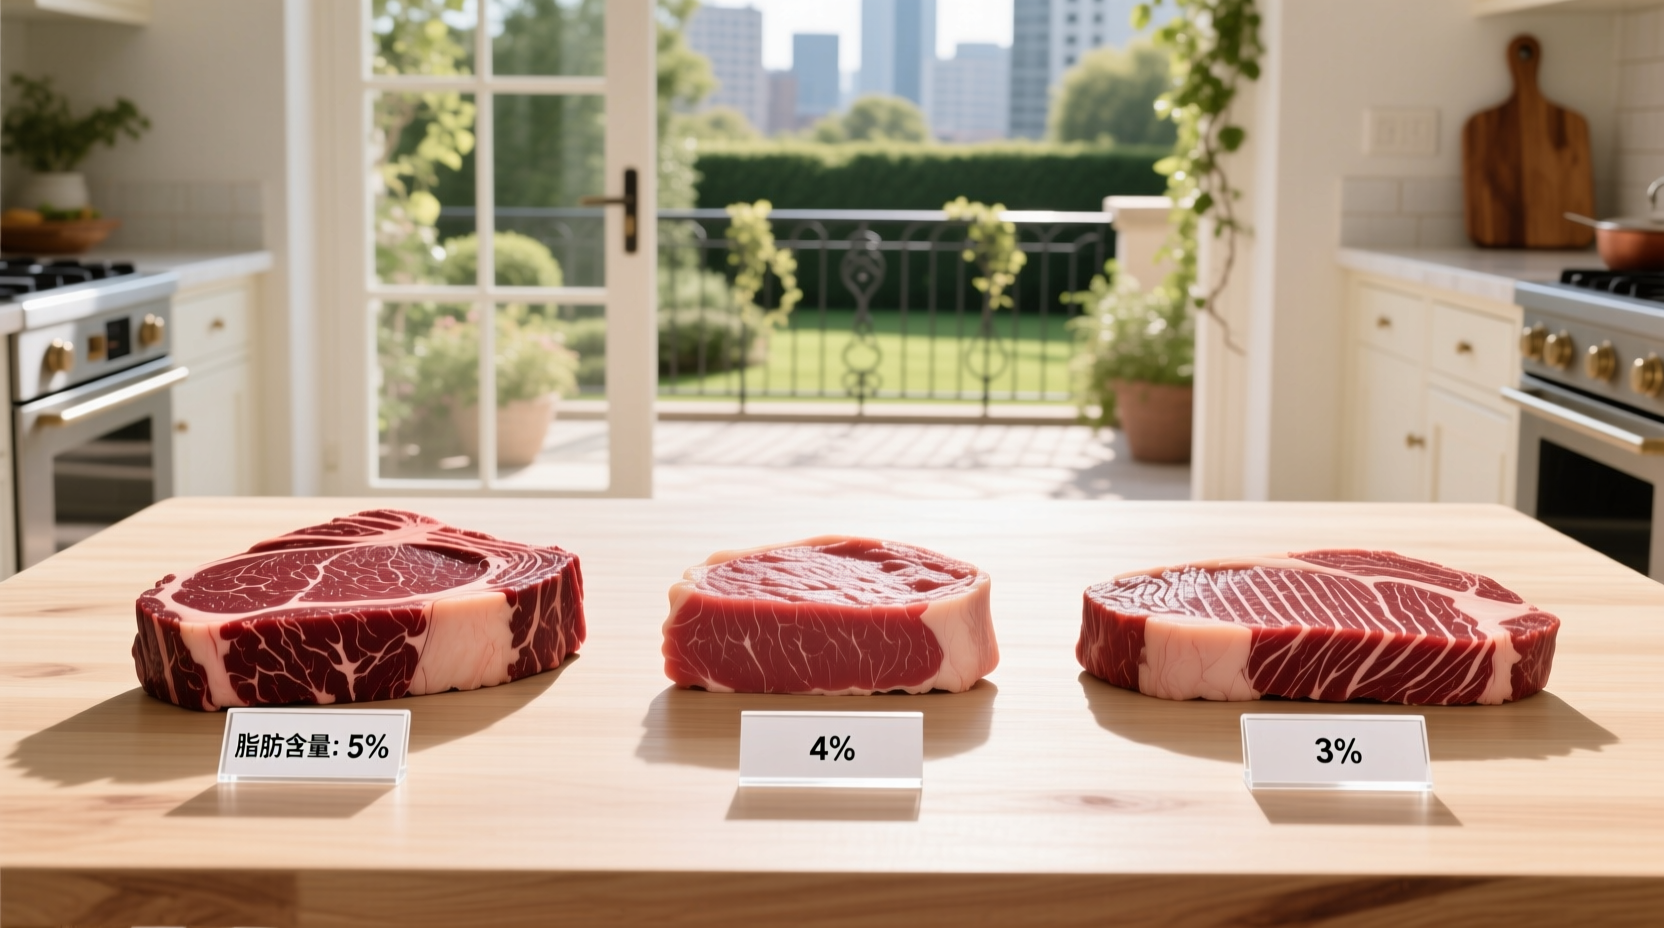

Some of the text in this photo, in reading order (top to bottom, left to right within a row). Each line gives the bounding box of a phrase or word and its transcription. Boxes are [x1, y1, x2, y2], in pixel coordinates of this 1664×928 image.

[347, 733, 389, 759] 5%
[809, 735, 856, 762] 4%
[1315, 737, 1363, 765] 3%
